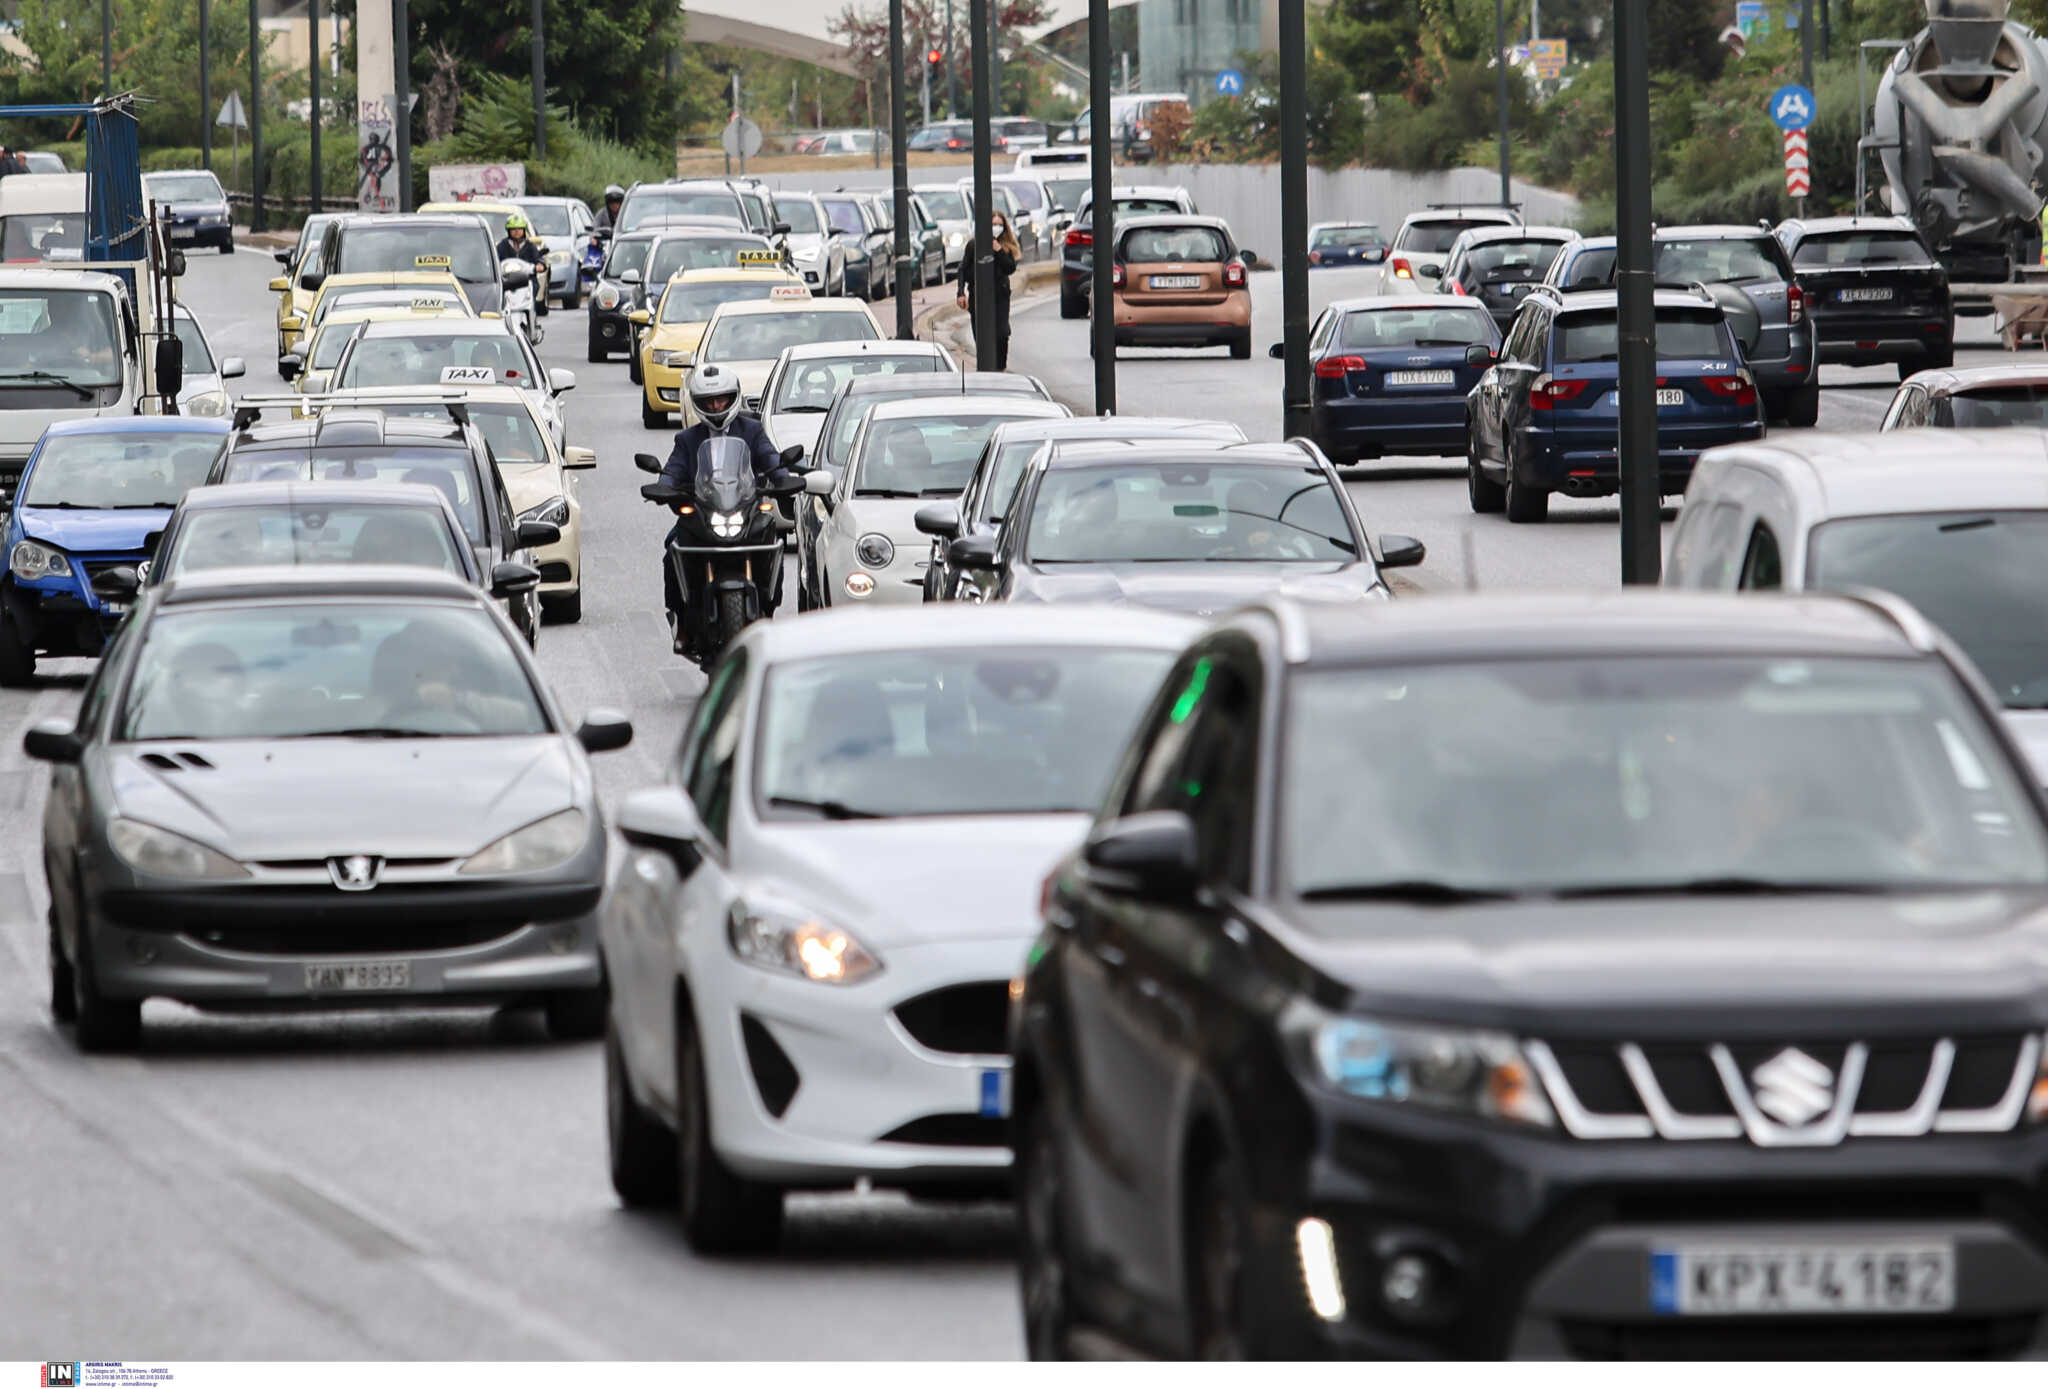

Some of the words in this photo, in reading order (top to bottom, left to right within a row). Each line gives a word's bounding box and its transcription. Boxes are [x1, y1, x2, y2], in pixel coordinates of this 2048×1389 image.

[743, 251, 776, 260] TAXI
[413, 299, 441, 307] TAXI
[447, 368, 489, 380] TAXI
